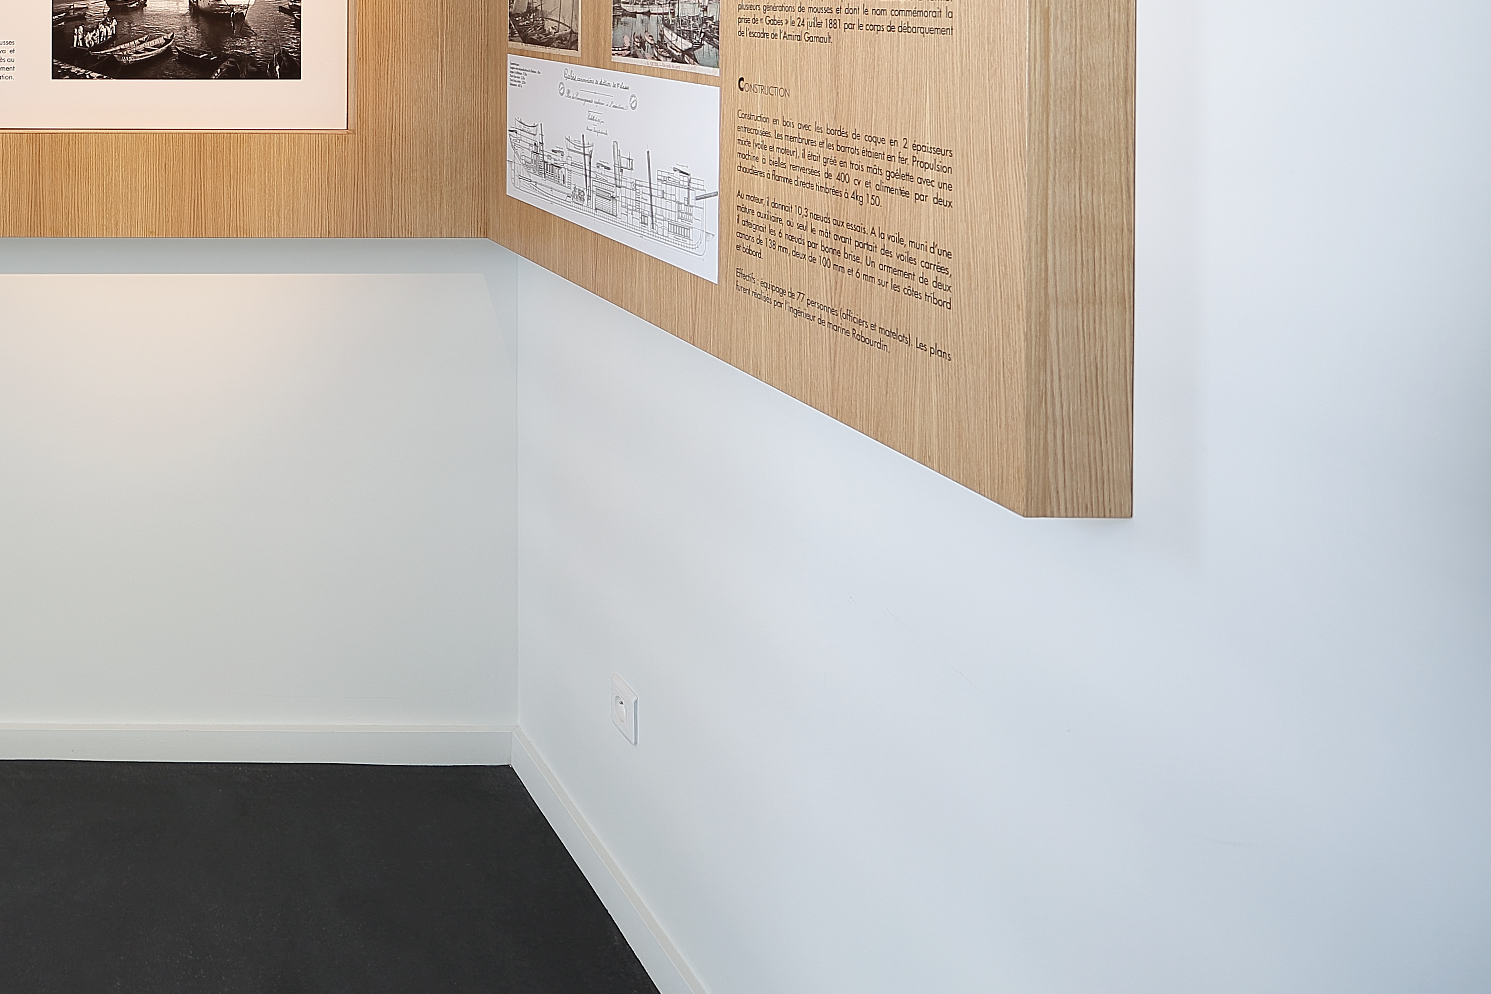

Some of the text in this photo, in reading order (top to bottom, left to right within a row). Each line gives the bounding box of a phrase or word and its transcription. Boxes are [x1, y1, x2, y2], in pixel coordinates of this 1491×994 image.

[890, 7, 942, 18] commémorait
[865, 23, 884, 35] corps
[898, 20, 954, 37] débarquement
[861, 146, 885, 161] étaient
[898, 151, 909, 166] fer.
[912, 155, 953, 174] Propulsion
[864, 134, 886, 147] coque
[912, 140, 953, 158] épaisseurs
[850, 159, 864, 172] trois
[866, 164, 883, 177] mâts
[886, 168, 914, 183] goélette
[917, 176, 935, 188] avec
[867, 193, 883, 208] 150.
[875, 179, 910, 199] alimentée
[933, 191, 953, 209] deux
[846, 222, 868, 236] essais.
[887, 232, 907, 249] voile,
[909, 239, 928, 253] muni
[930, 241, 952, 260] d'une
[844, 247, 862, 265] brise.
[879, 262, 915, 282] armement
[932, 274, 952, 293] deux
[855, 239, 877, 254] portait
[896, 250, 917, 266] voiles
[920, 259, 952, 278] carrées,
[903, 285, 922, 300] côtes
[924, 291, 952, 310] tribord
[840, 307, 869, 329] (officiers
[879, 326, 913, 348] matelots).
[930, 342, 951, 361] plans
[852, 327, 890, 353] Rabourdin.
